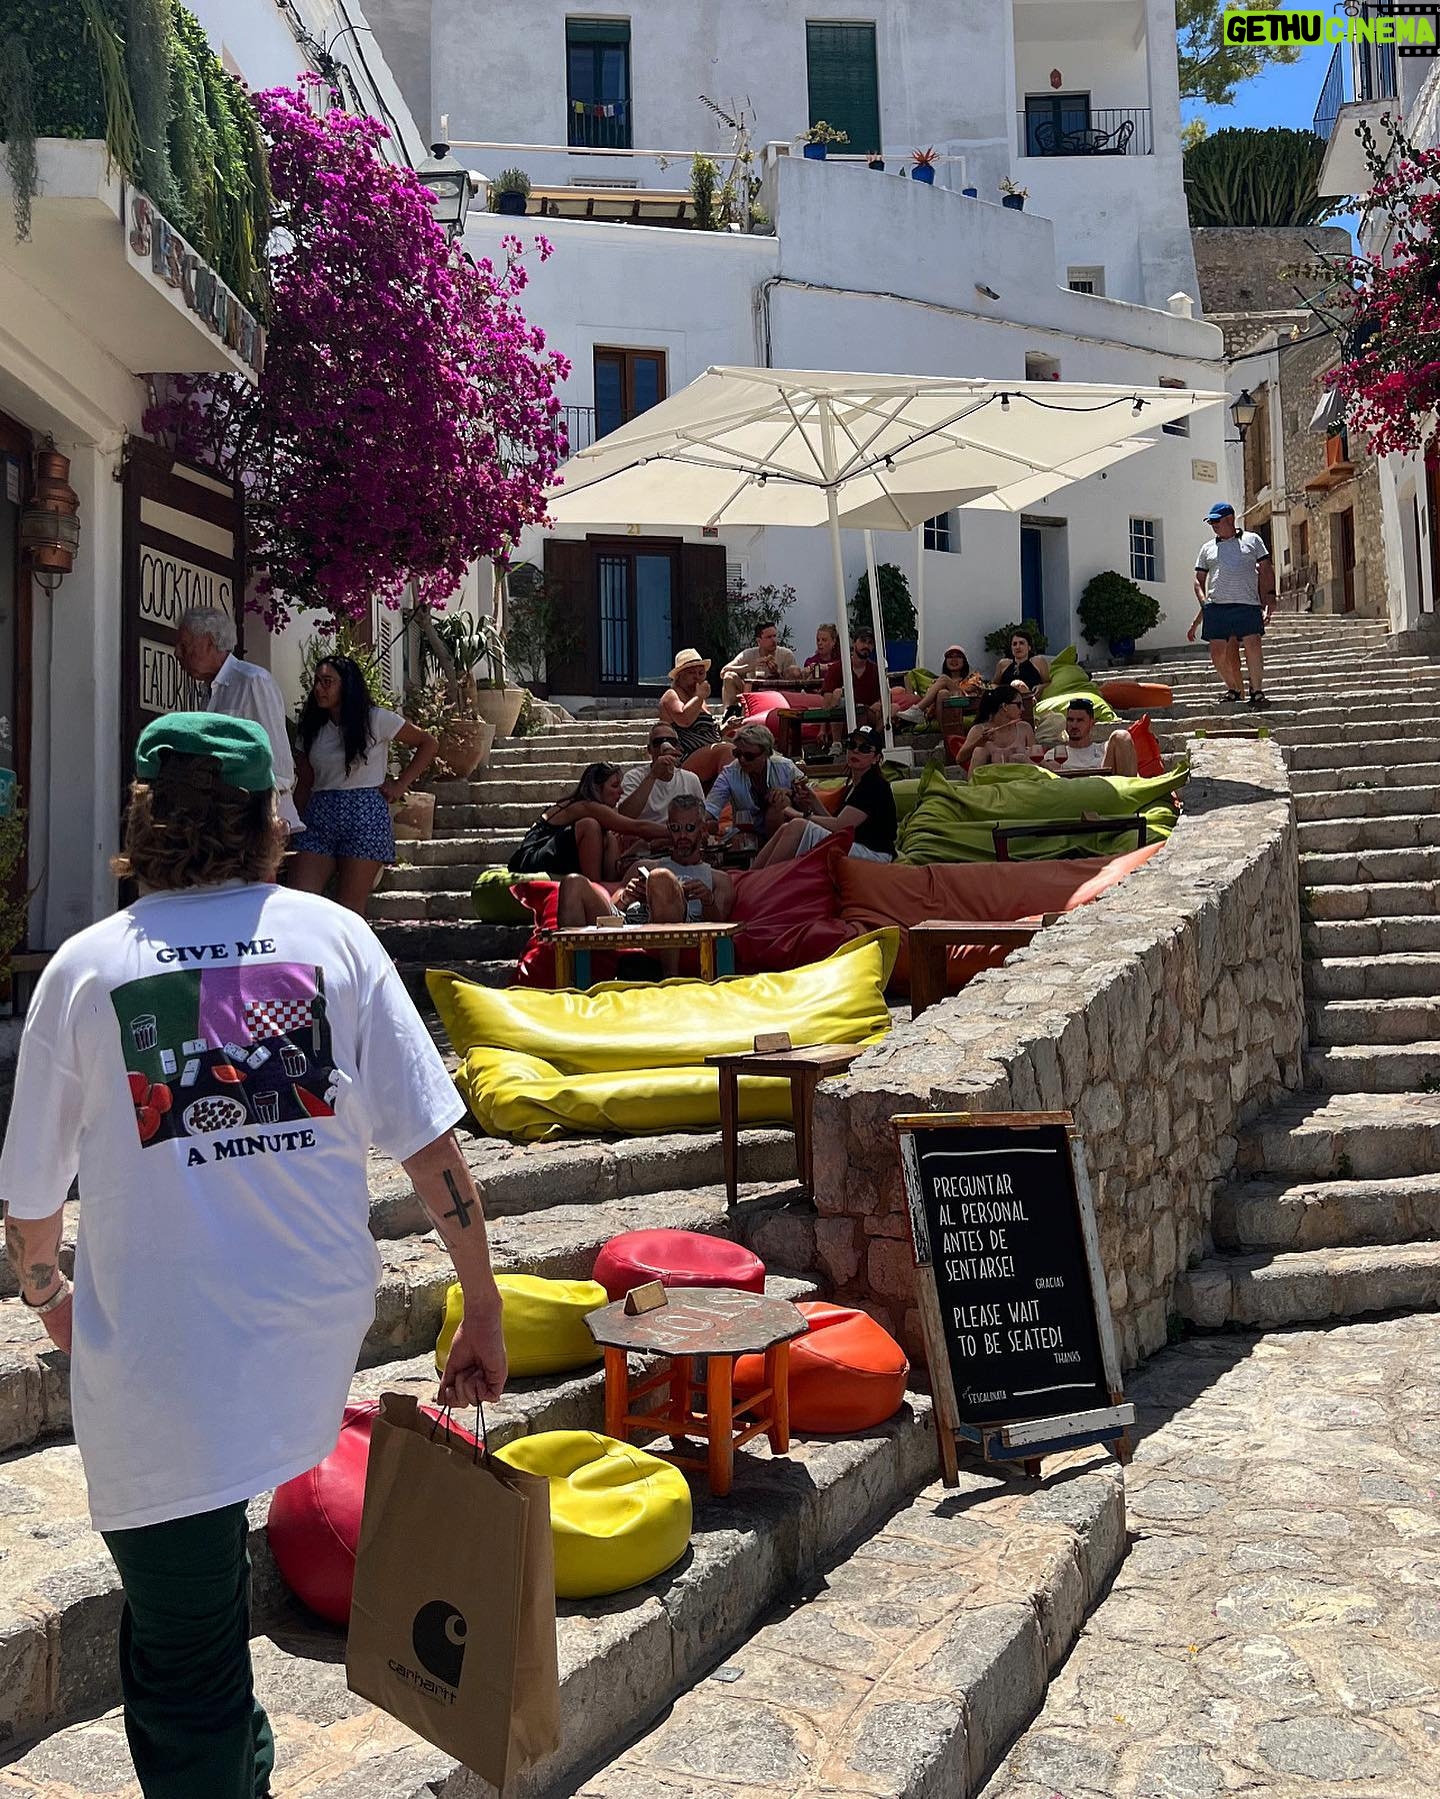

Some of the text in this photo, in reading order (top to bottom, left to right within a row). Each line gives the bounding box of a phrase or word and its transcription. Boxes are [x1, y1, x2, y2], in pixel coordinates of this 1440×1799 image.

[156, 938, 277, 964] GIVE ME
[187, 1129, 316, 1167] A MINUTE
[933, 1174, 1013, 1198] PREGUNTAR
[940, 1200, 1029, 1226] AL PERSONAL
[944, 1229, 1008, 1253] ANTES DE
[945, 1256, 1015, 1281] SENTARSE!
[1035, 1276, 1065, 1290] GRACIAS
[953, 1300, 1039, 1328] PLEASE WAIT
[957, 1326, 1063, 1357] TO BE SEATED!
[1054, 1351, 1081, 1364] THANKS
